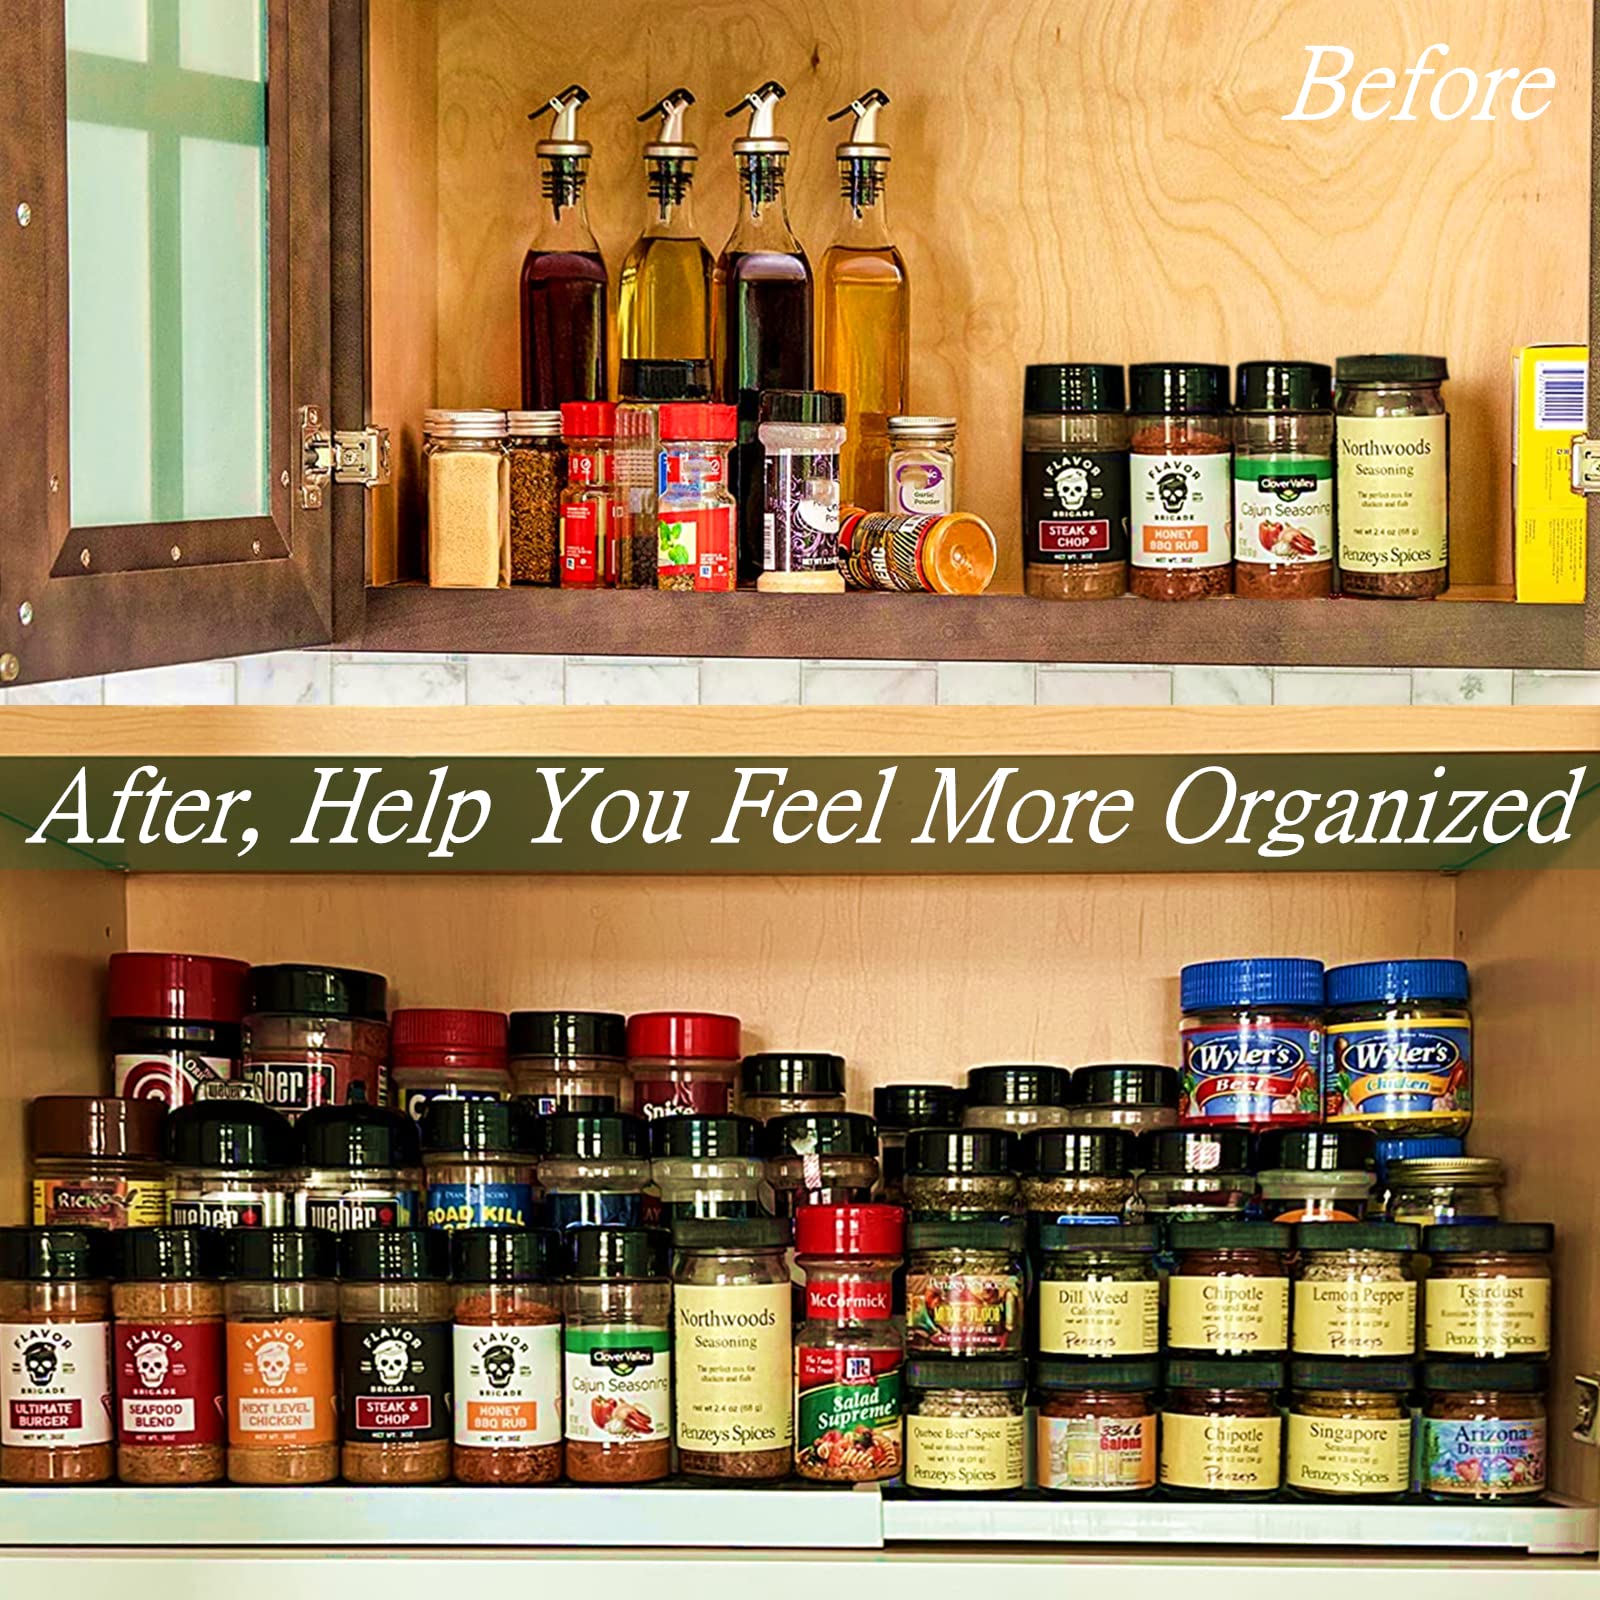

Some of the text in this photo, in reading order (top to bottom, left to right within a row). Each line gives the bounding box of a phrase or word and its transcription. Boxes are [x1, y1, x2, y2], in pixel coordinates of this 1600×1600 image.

[1342, 439, 1431, 456] Northwoods
[1046, 456, 1101, 476] FLAVOR
[1148, 461, 1201, 480] FLAVOR
[1356, 464, 1414, 477] Seasoning
[914, 498, 940, 506] Powder
[1241, 503, 1330, 518] Cajun Seasoning
[1049, 525, 1098, 536] STEAK &
[1154, 529, 1193, 540] HONEY
[1057, 537, 1090, 547] CHOP
[1150, 540, 1199, 551] BBQ RUB
[1343, 545, 1431, 567] Penzeys Spices
[1201, 1043, 1291, 1071] Wyler's
[1357, 1043, 1448, 1071] Wyler's
[253, 1065, 304, 1102] eber
[427, 1204, 474, 1227] ROAD
[482, 1204, 526, 1227] KILL
[1059, 1289, 1128, 1304] Dill Weed
[1202, 1286, 1263, 1303] Chipotle
[1313, 1287, 1405, 1304] Lemon Pepper
[1458, 1284, 1524, 1299] Tsardust
[810, 1292, 885, 1309] McCormick
[680, 1308, 775, 1328] Northwoods
[14, 1329, 72, 1350] FLAVOR
[126, 1330, 183, 1351] FLAVOR
[245, 1329, 305, 1350] FLAVOR
[363, 1327, 422, 1349] FLAVOR
[472, 1332, 529, 1352] FLAVOR
[695, 1335, 757, 1350] Seasoning
[1063, 1331, 1116, 1349] Penzeys
[1202, 1325, 1258, 1343] Penzeys
[1328, 1331, 1383, 1349] Penzeys
[1500, 1333, 1536, 1348] Spices
[572, 1376, 668, 1394] Cajun Seasoning
[15, 1403, 73, 1414] ULTIMATE
[242, 1402, 310, 1414] NEXT LEVEL
[366, 1401, 418, 1412] STEAK &
[833, 1387, 879, 1413] Salad
[129, 1404, 183, 1415] SEAFOOD
[479, 1405, 521, 1416] HONEY
[818, 1403, 892, 1430] Supreme
[19, 1415, 69, 1427] BURGER
[135, 1417, 175, 1427] BLEND
[249, 1415, 302, 1426] CHICKEN
[375, 1414, 410, 1425] CHOP
[474, 1417, 527, 1428] BBQ RUB
[681, 1423, 776, 1446] Penzeys Spices
[975, 1428, 1000, 1441] Spice
[1204, 1426, 1263, 1442] Chipotle
[1310, 1423, 1387, 1443] Singapore
[1455, 1425, 1529, 1442] Arizona
[1457, 1443, 1527, 1457] Dreaming
[914, 1464, 996, 1482] Penzeys Spices
[1204, 1465, 1258, 1483] Penzeys
[1301, 1464, 1389, 1486] Penzeys Spices
